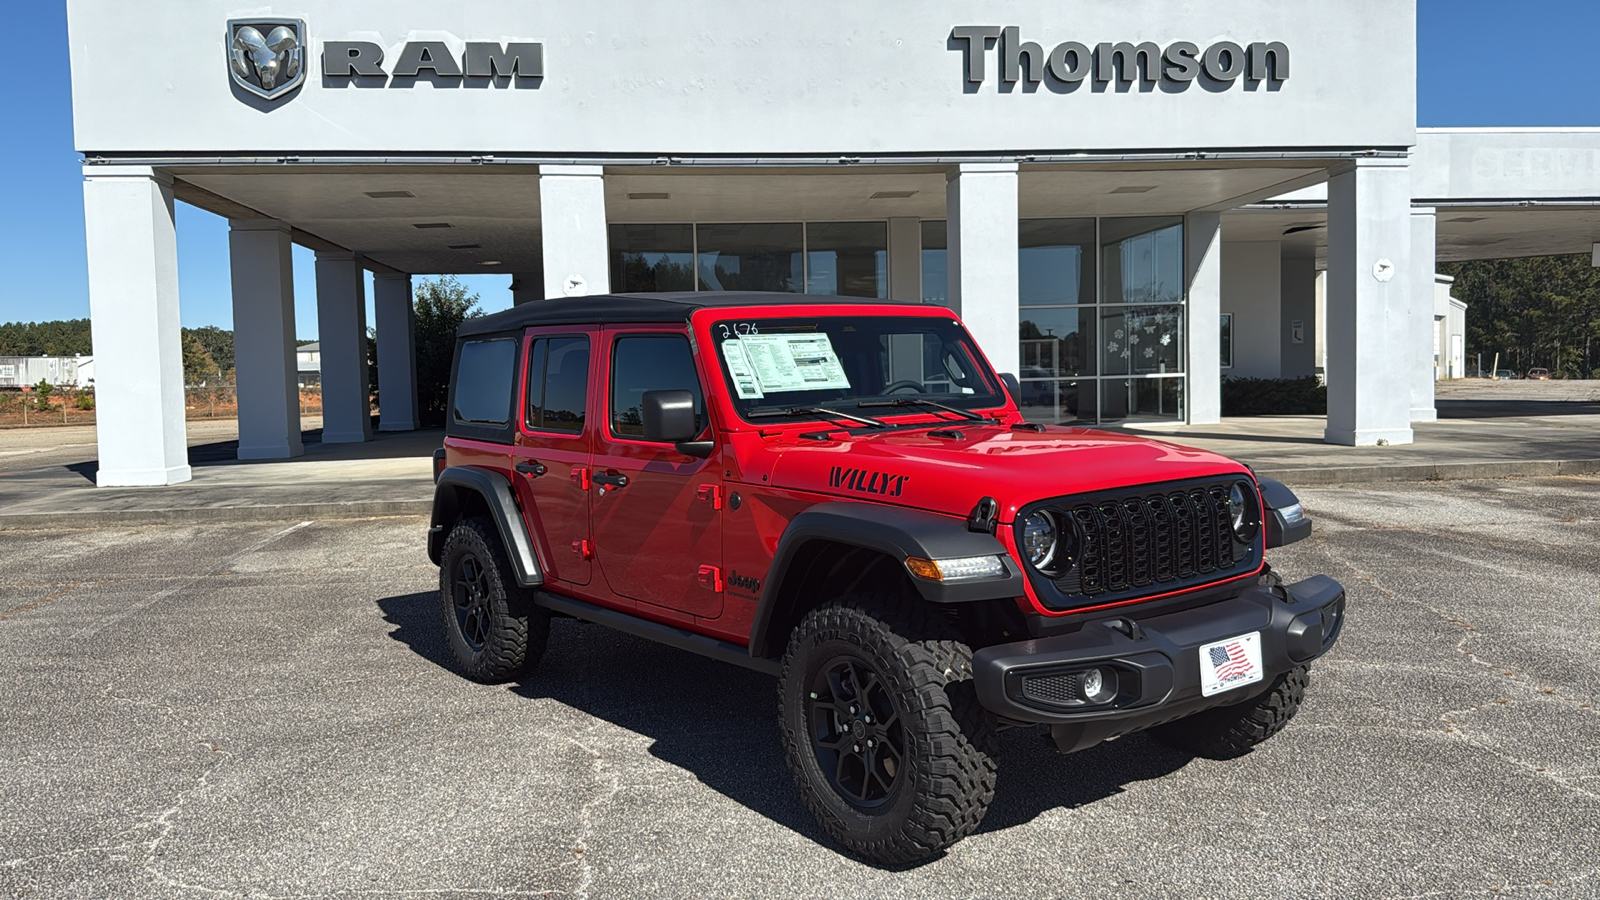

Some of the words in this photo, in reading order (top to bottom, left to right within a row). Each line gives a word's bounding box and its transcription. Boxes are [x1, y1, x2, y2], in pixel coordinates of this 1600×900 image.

[323, 41, 544, 77] RAM
[952, 26, 1290, 82] Thomson
[719, 323, 759, 339] 2676
[829, 466, 910, 497] WILLYS
[728, 569, 760, 594] Jeep
